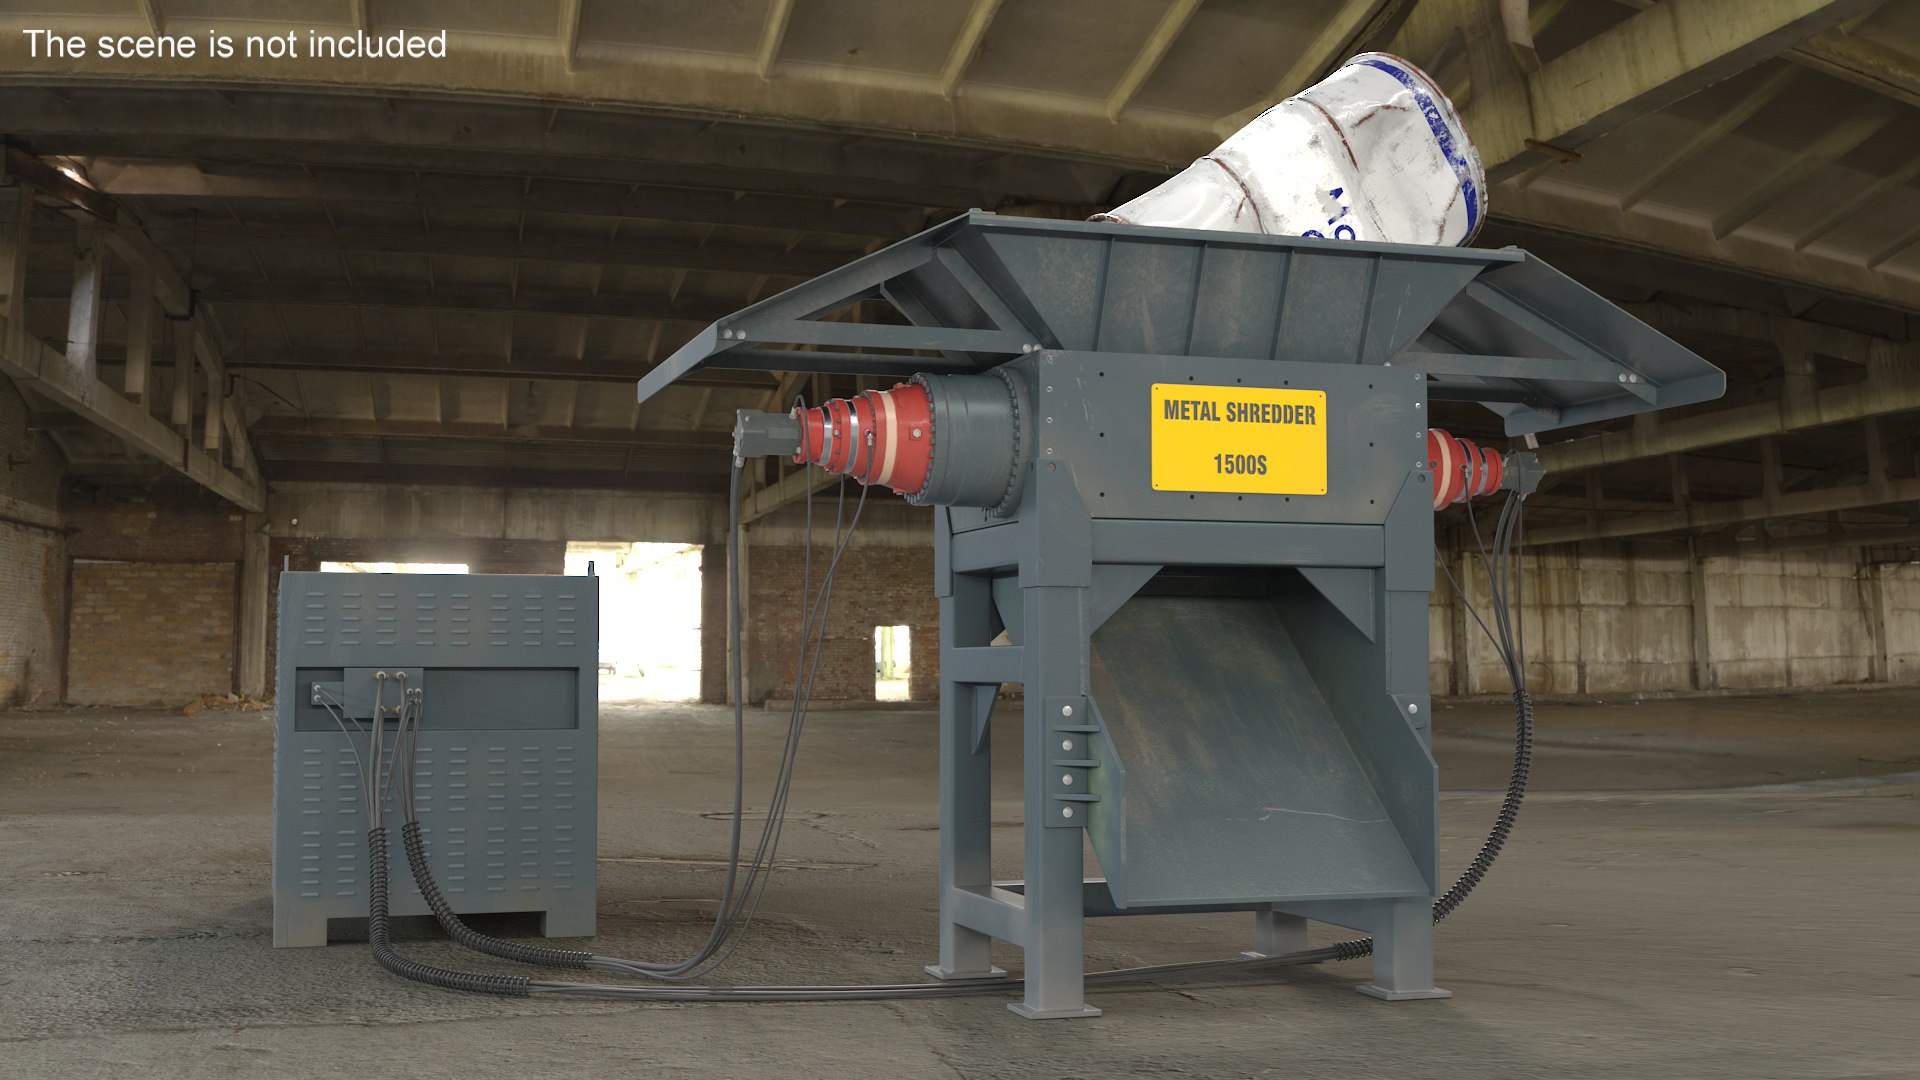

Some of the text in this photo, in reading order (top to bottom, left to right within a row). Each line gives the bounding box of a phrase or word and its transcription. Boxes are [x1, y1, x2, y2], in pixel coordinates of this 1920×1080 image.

[1164, 399, 1317, 426] METAL SHREDDER
[1214, 453, 1268, 476] 1500S
